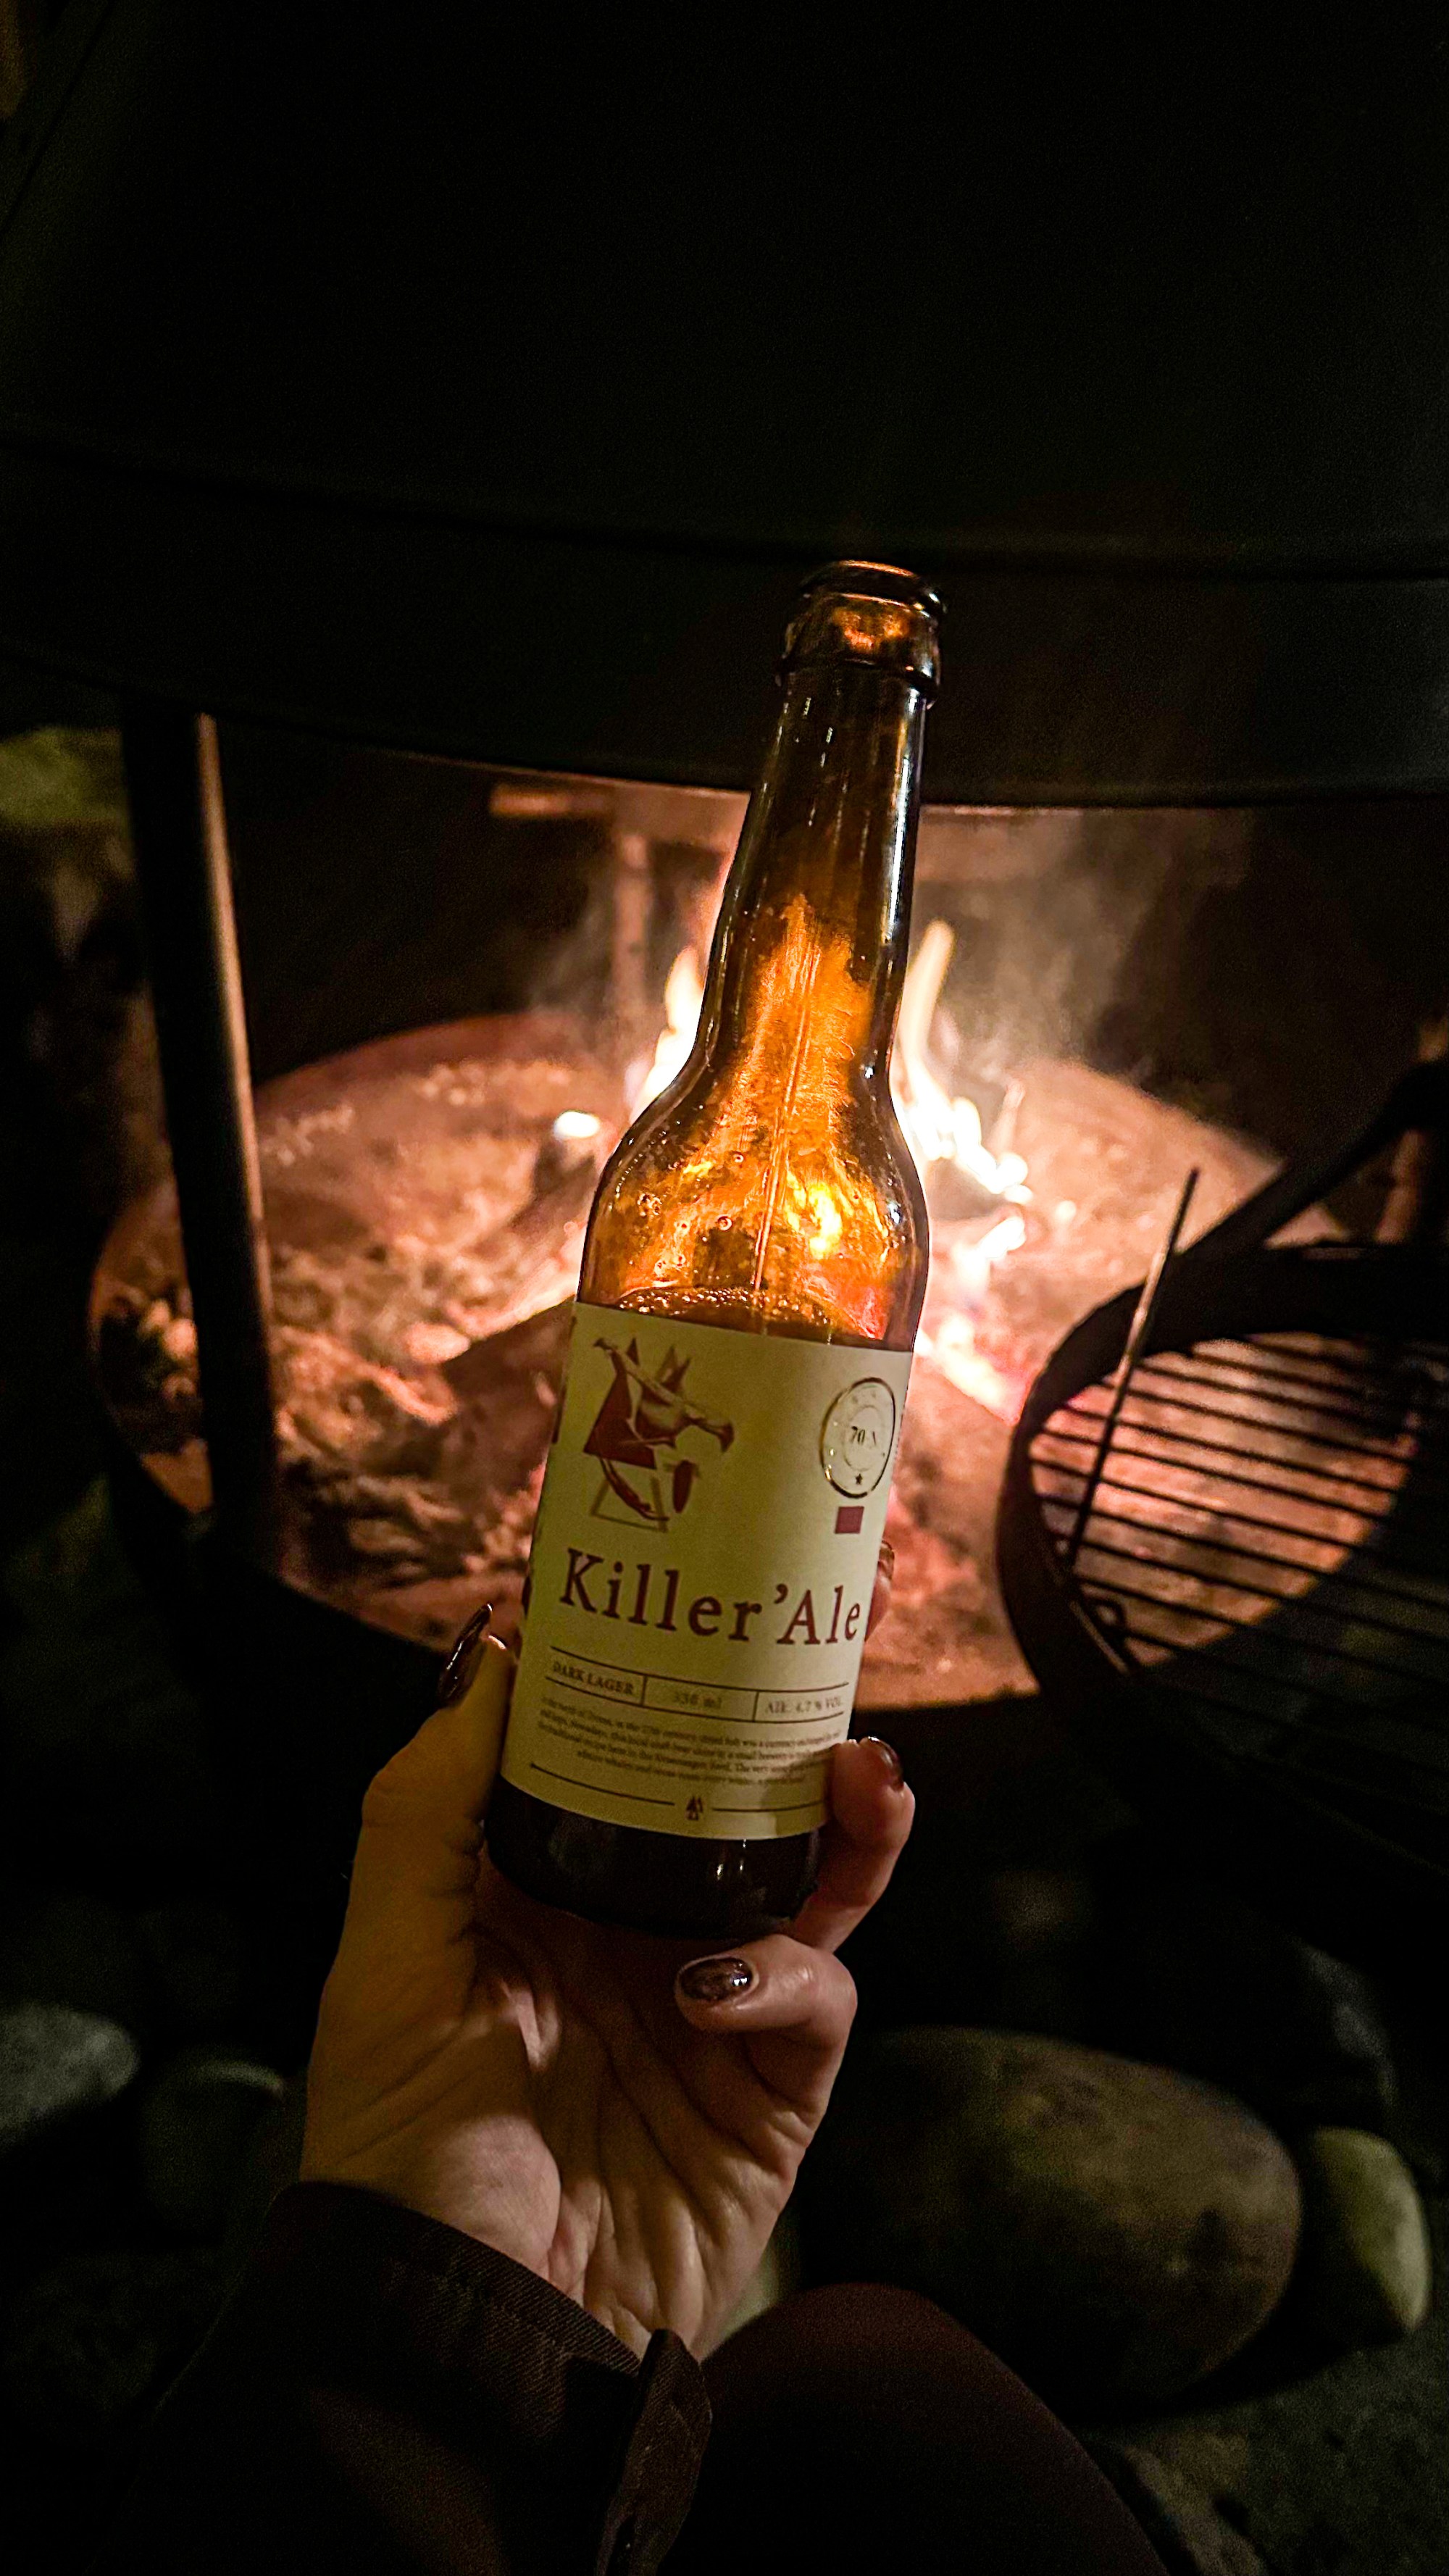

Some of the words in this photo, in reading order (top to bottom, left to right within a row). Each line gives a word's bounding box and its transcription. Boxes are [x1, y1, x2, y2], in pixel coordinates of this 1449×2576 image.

[559, 1547, 861, 1646] Killer'Ale
[553, 1660, 585, 1683] DARK
[586, 1671, 635, 1695] LAGER
